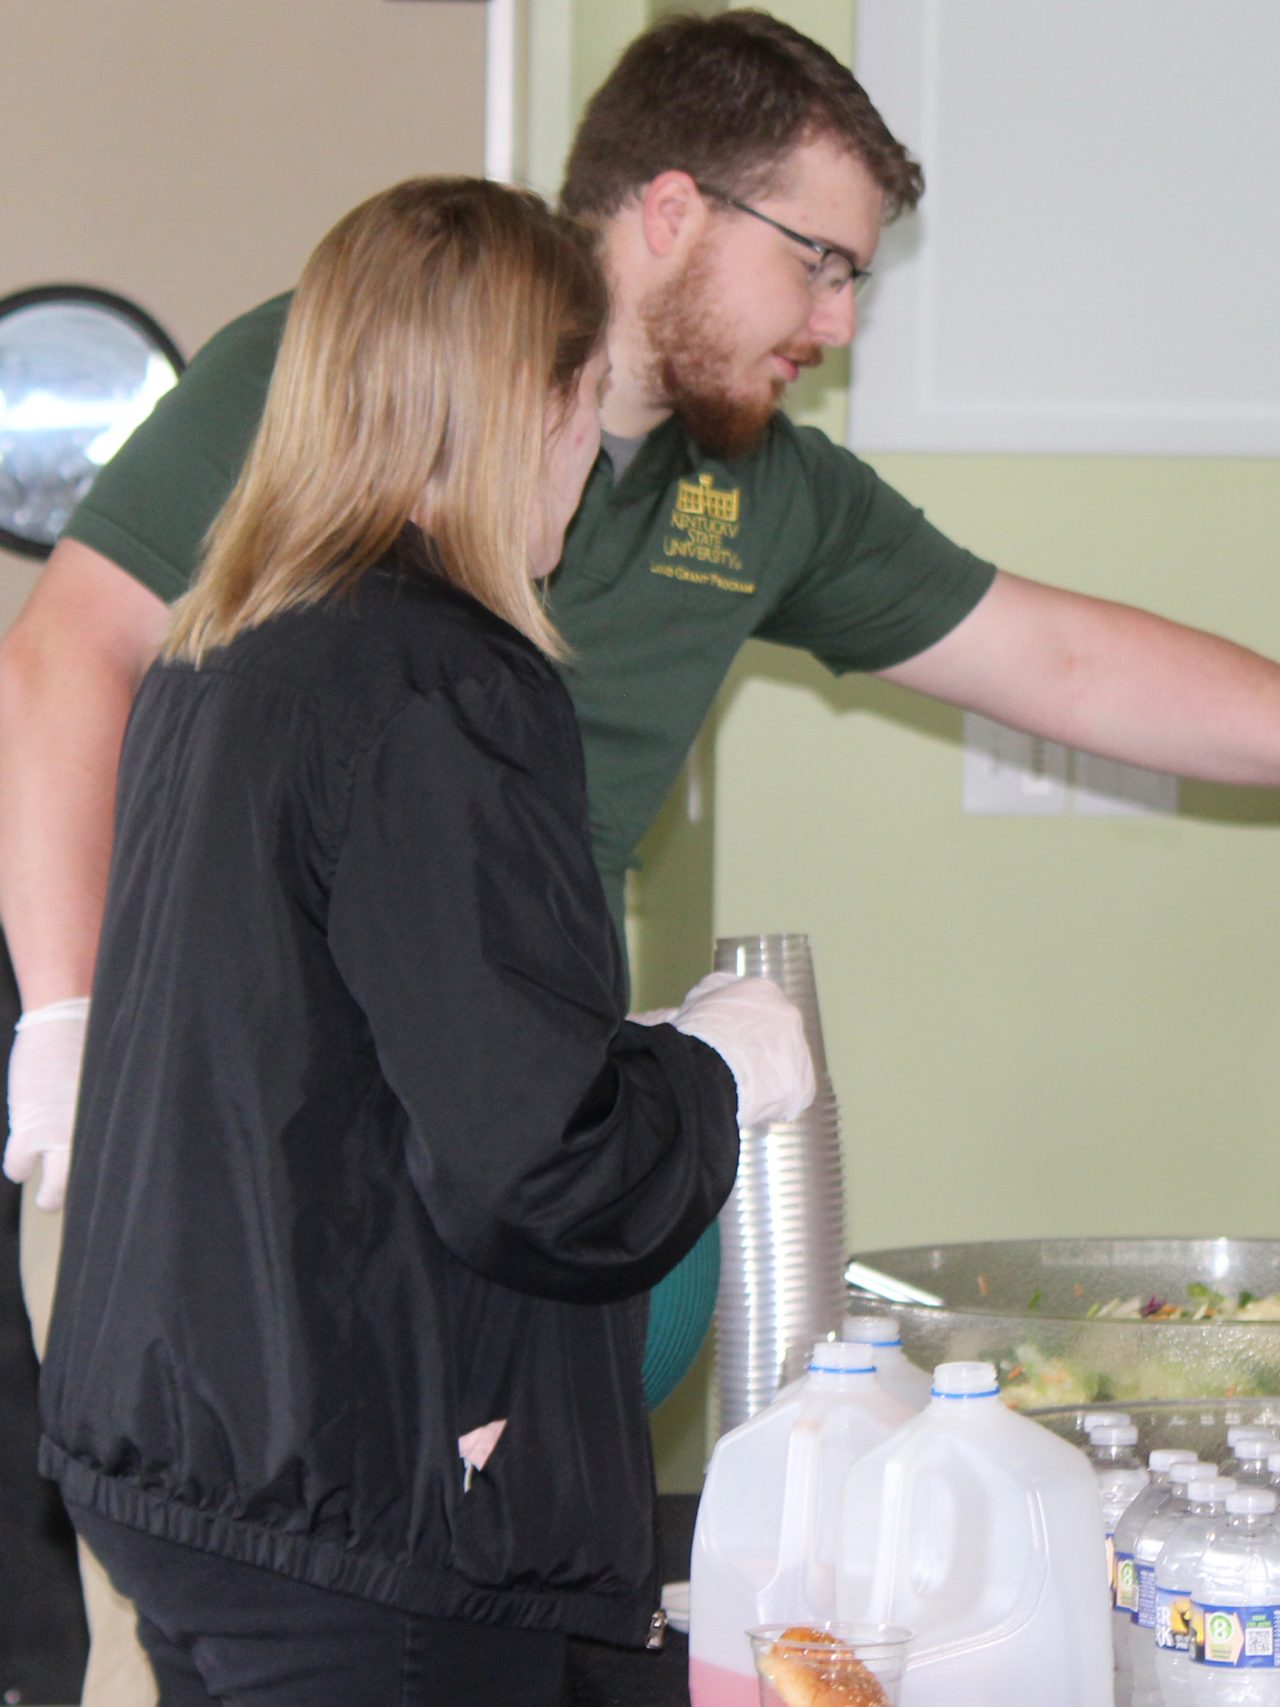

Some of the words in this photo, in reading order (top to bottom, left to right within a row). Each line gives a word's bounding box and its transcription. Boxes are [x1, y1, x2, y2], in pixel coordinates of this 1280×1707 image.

[670, 511, 739, 538] KENTUCKY
[687, 528, 722, 549] STATE
[663, 536, 737, 570] UNIVERSITY
